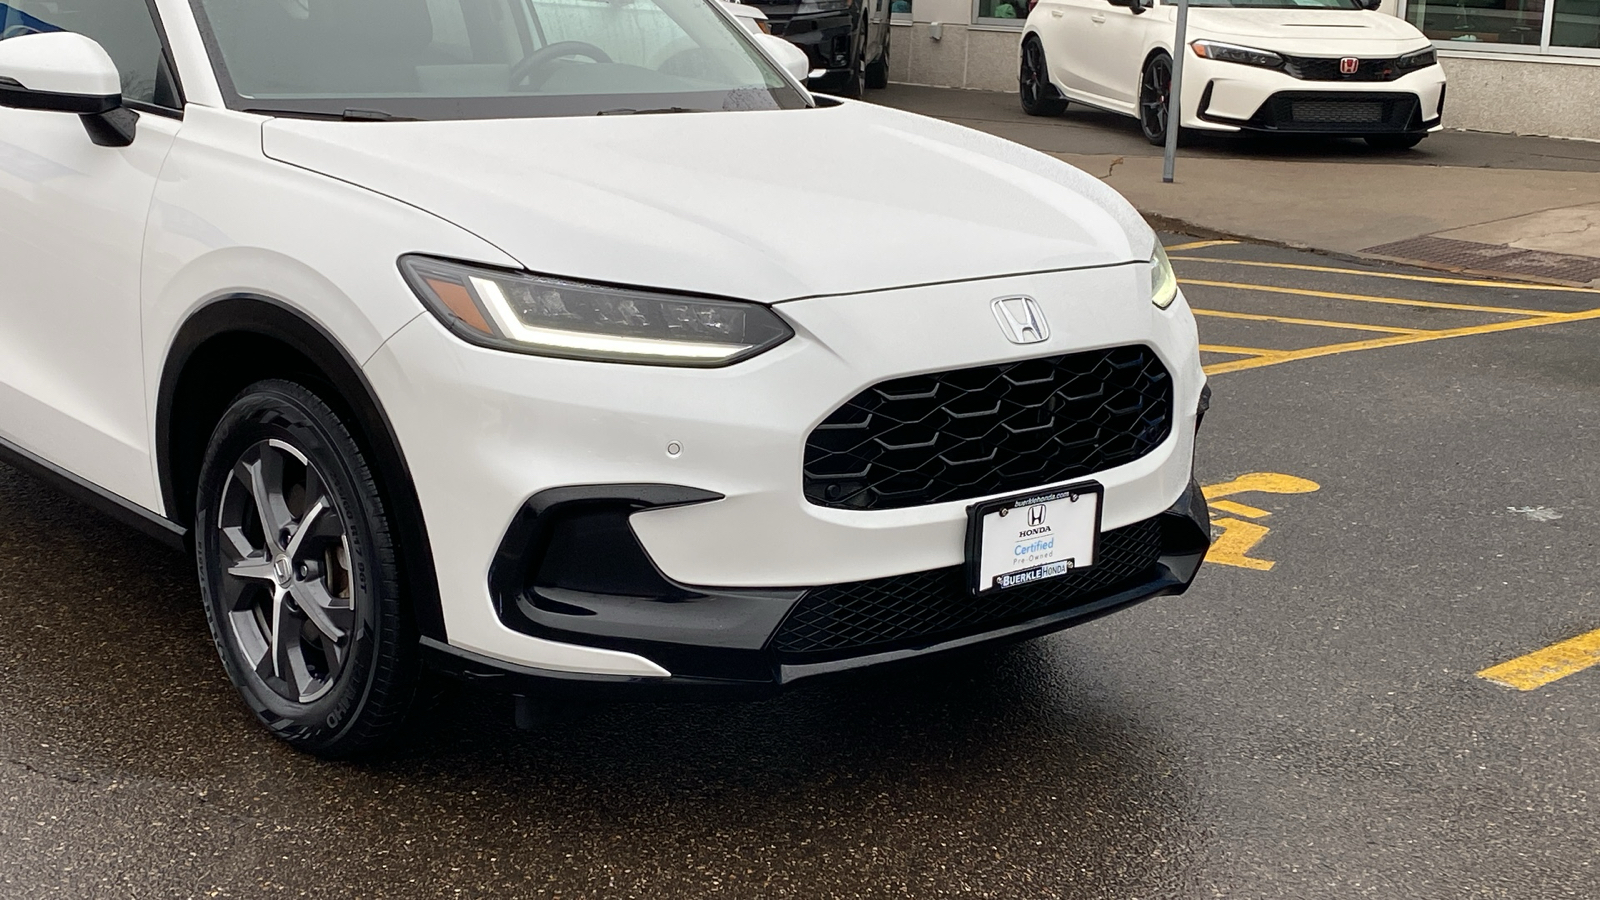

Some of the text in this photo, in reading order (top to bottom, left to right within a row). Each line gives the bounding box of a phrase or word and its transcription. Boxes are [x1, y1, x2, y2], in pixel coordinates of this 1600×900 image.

[1014, 491, 1070, 507] buerklehonda.com
[1019, 526, 1052, 538] HONDA
[1014, 537, 1054, 556] Certified
[1013, 551, 1054, 565] Pre-Owned
[326, 659, 366, 729] KUMHO
